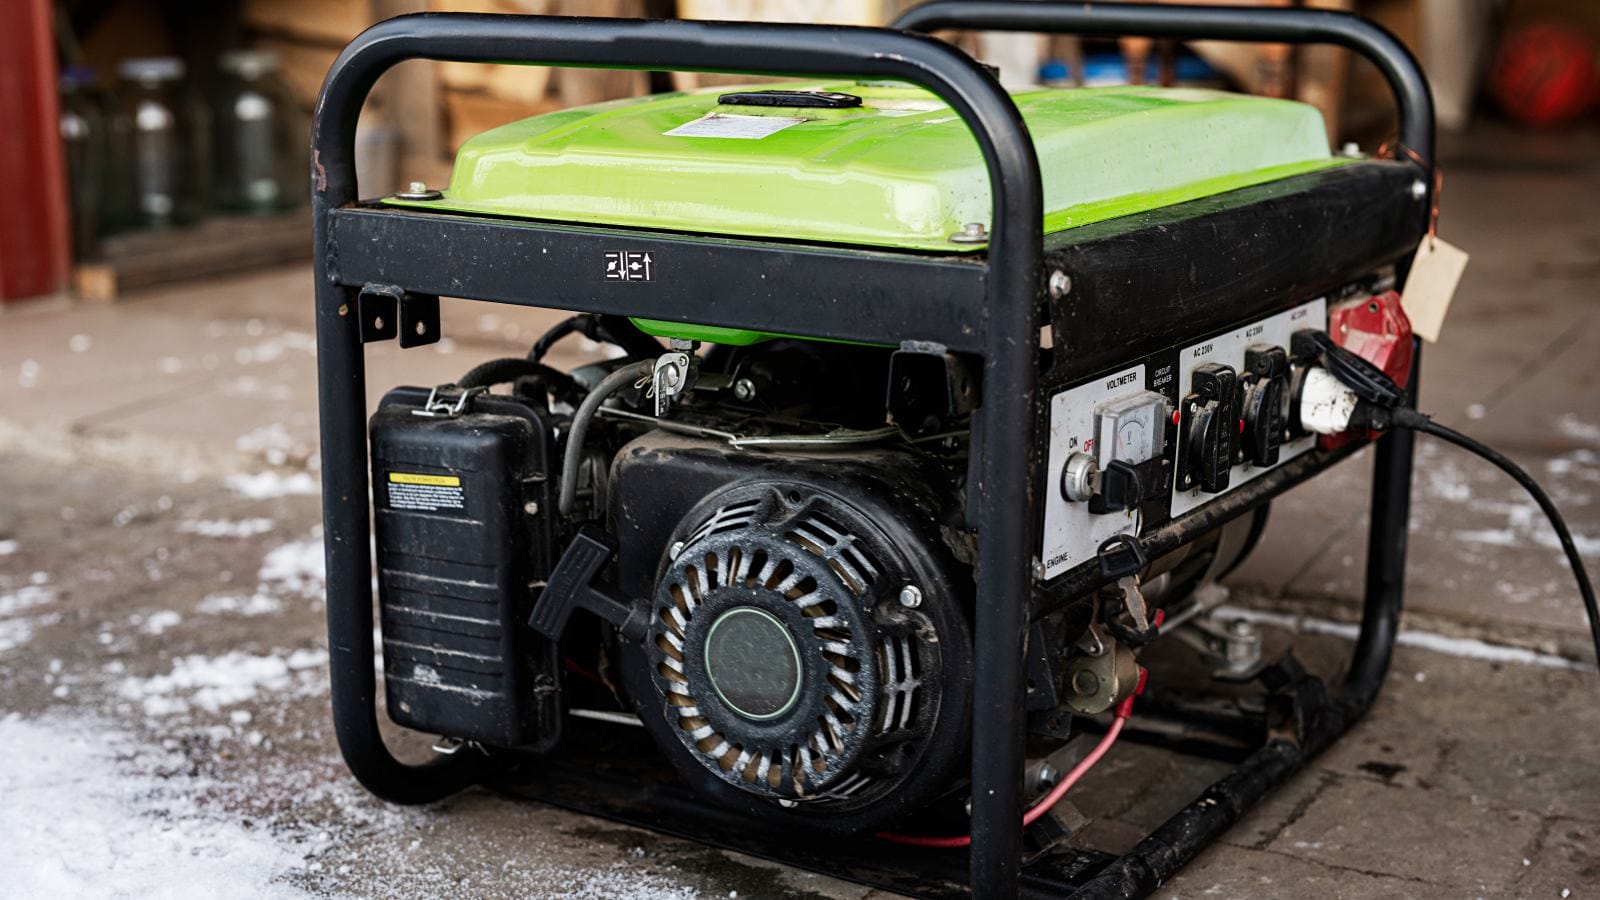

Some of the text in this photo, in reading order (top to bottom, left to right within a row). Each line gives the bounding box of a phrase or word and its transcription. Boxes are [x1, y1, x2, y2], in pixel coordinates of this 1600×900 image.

[1193, 343, 1214, 359] AC 230V
[1154, 365, 1171, 378] CIRCUIT
[1106, 371, 1137, 391] VOLTMETER
[1153, 374, 1172, 388] BREAKER
[1069, 436, 1078, 448] ON
[1046, 551, 1069, 569] ENGINE
